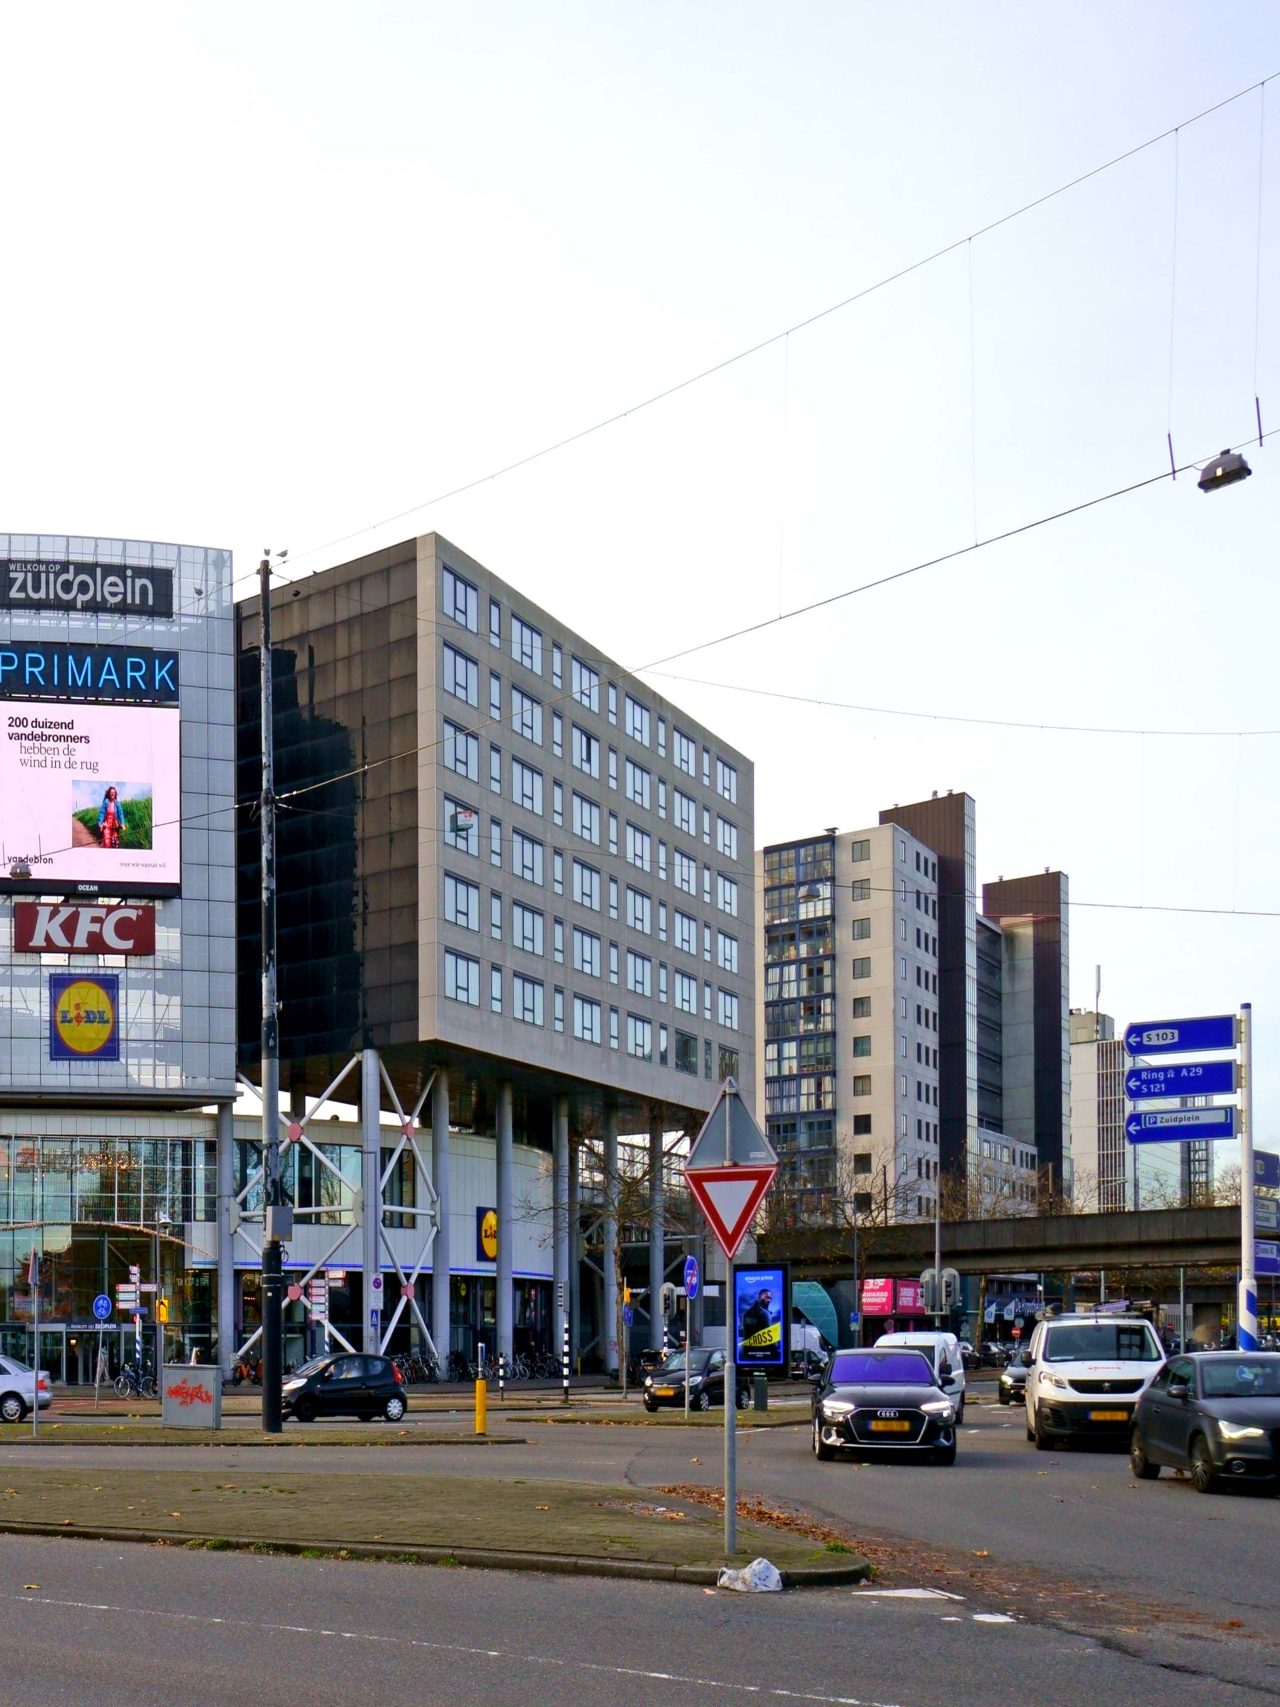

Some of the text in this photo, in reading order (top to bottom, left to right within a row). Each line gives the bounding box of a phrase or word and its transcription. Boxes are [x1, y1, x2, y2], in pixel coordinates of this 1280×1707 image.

[9, 563, 61, 573] WELKOM OP
[8, 565, 154, 609] zuidplein
[8, 716, 74, 731] 200 duizend
[8, 731, 90, 744] vandebronners
[20, 742, 76, 757] hebben de
[20, 756, 99, 774] wind in de rug
[7, 855, 53, 865] vandebron
[78, 884, 98, 892] OCEAN
[29, 906, 137, 949] KFC
[1146, 1031, 1175, 1042] S 103
[1141, 1071, 1164, 1081] Ring
[1142, 1084, 1165, 1093] S 121
[1159, 1114, 1200, 1125] Zuidplein
[748, 1330, 773, 1346] CROSS
